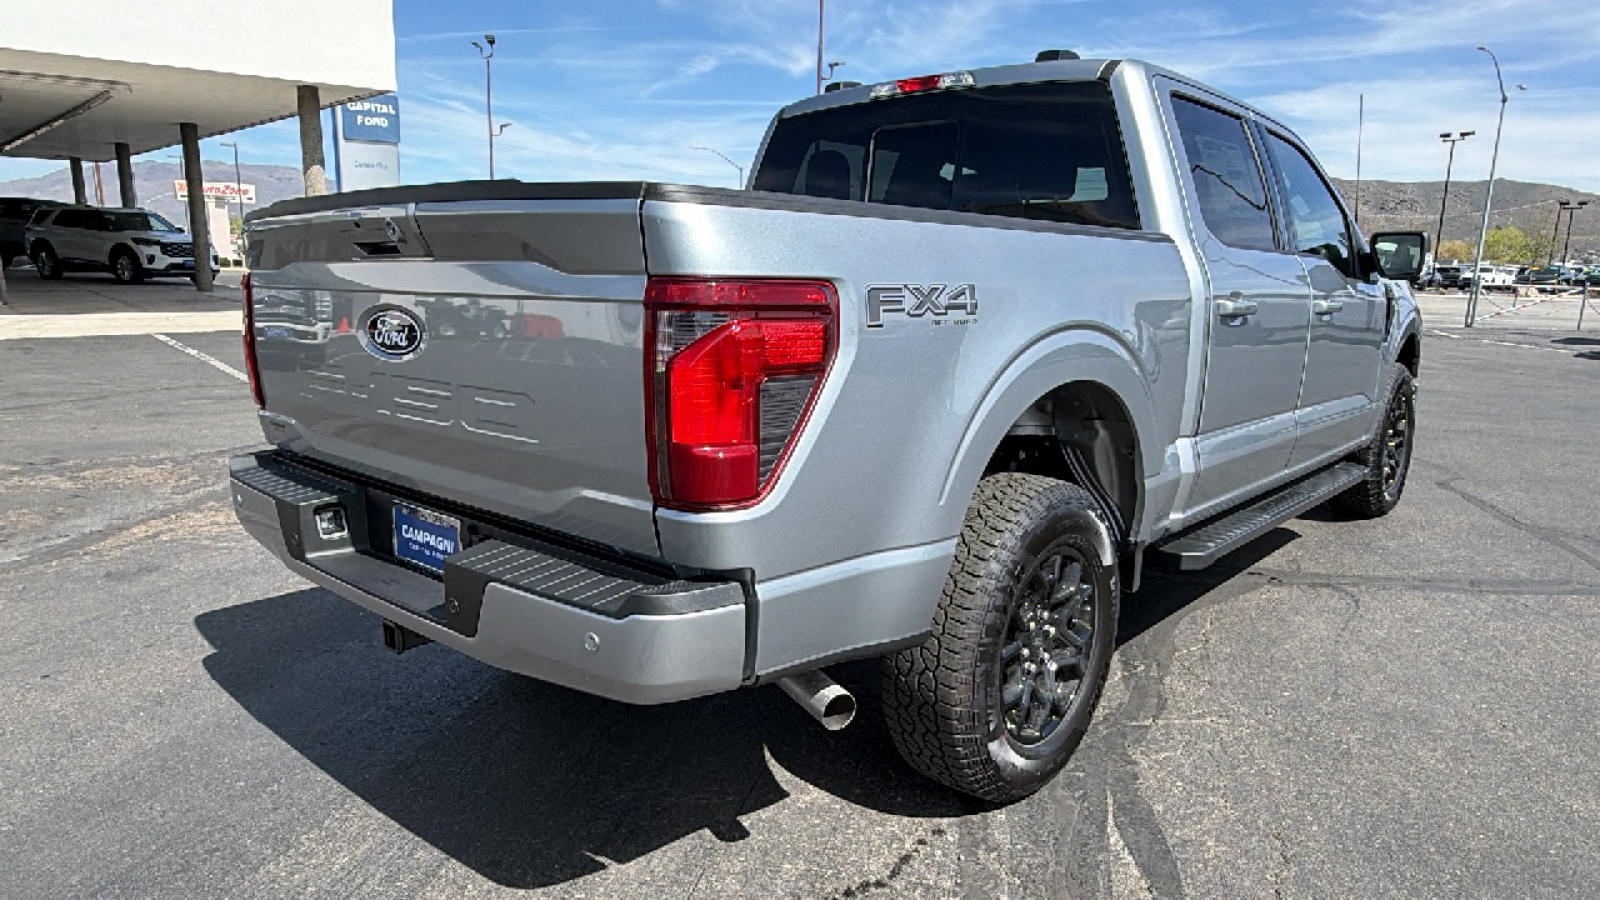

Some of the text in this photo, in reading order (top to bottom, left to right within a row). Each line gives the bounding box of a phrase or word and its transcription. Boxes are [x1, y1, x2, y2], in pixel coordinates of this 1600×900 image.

[346, 102, 395, 114] CAPITAL
[356, 115, 388, 127] FORD
[865, 284, 978, 328] FX4
[374, 316, 409, 347] Ford
[402, 525, 454, 554] CAMPAGNI
